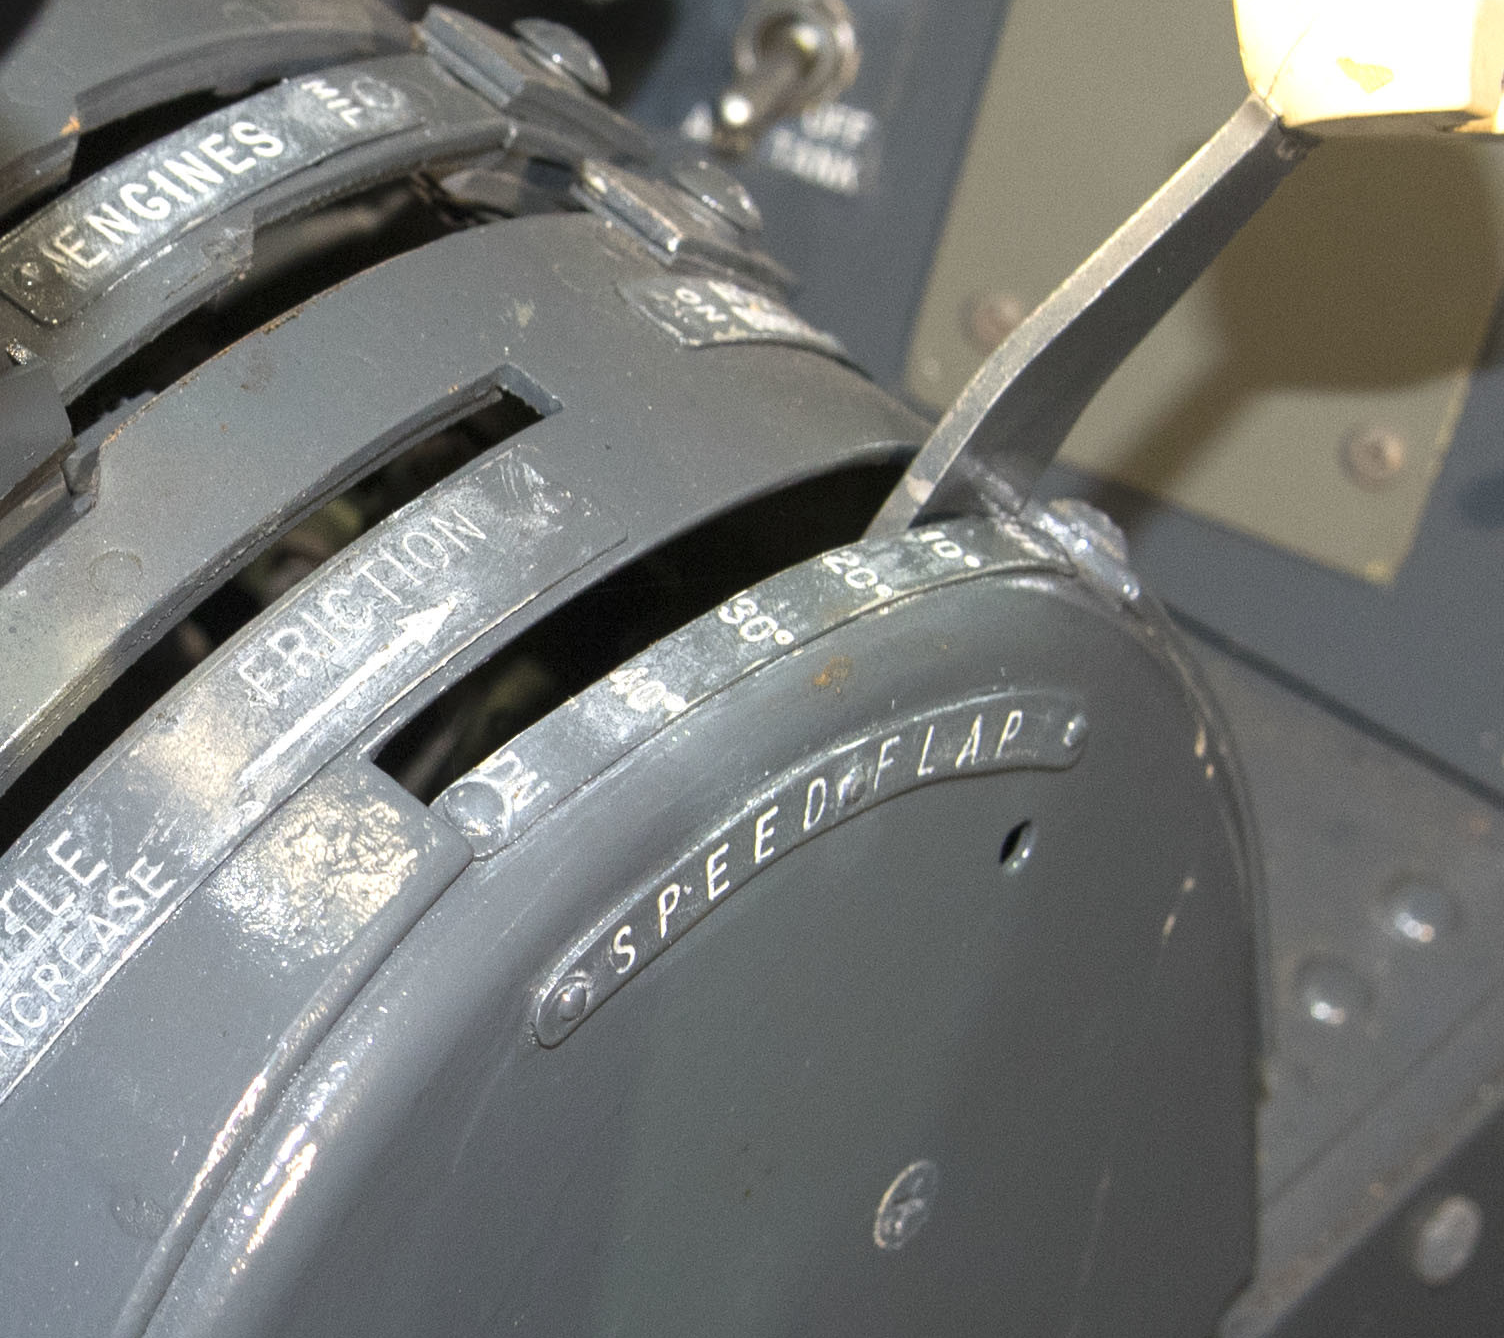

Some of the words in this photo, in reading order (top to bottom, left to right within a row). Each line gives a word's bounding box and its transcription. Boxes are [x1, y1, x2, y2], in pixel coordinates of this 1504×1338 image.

[300, 77, 366, 129] MIL
[50, 120, 285, 270] ENGINES
[675, 287, 729, 323] ON
[238, 508, 488, 707] FRICTION
[610, 775, 830, 974] SPEED
[873, 709, 1024, 797] FLAP
